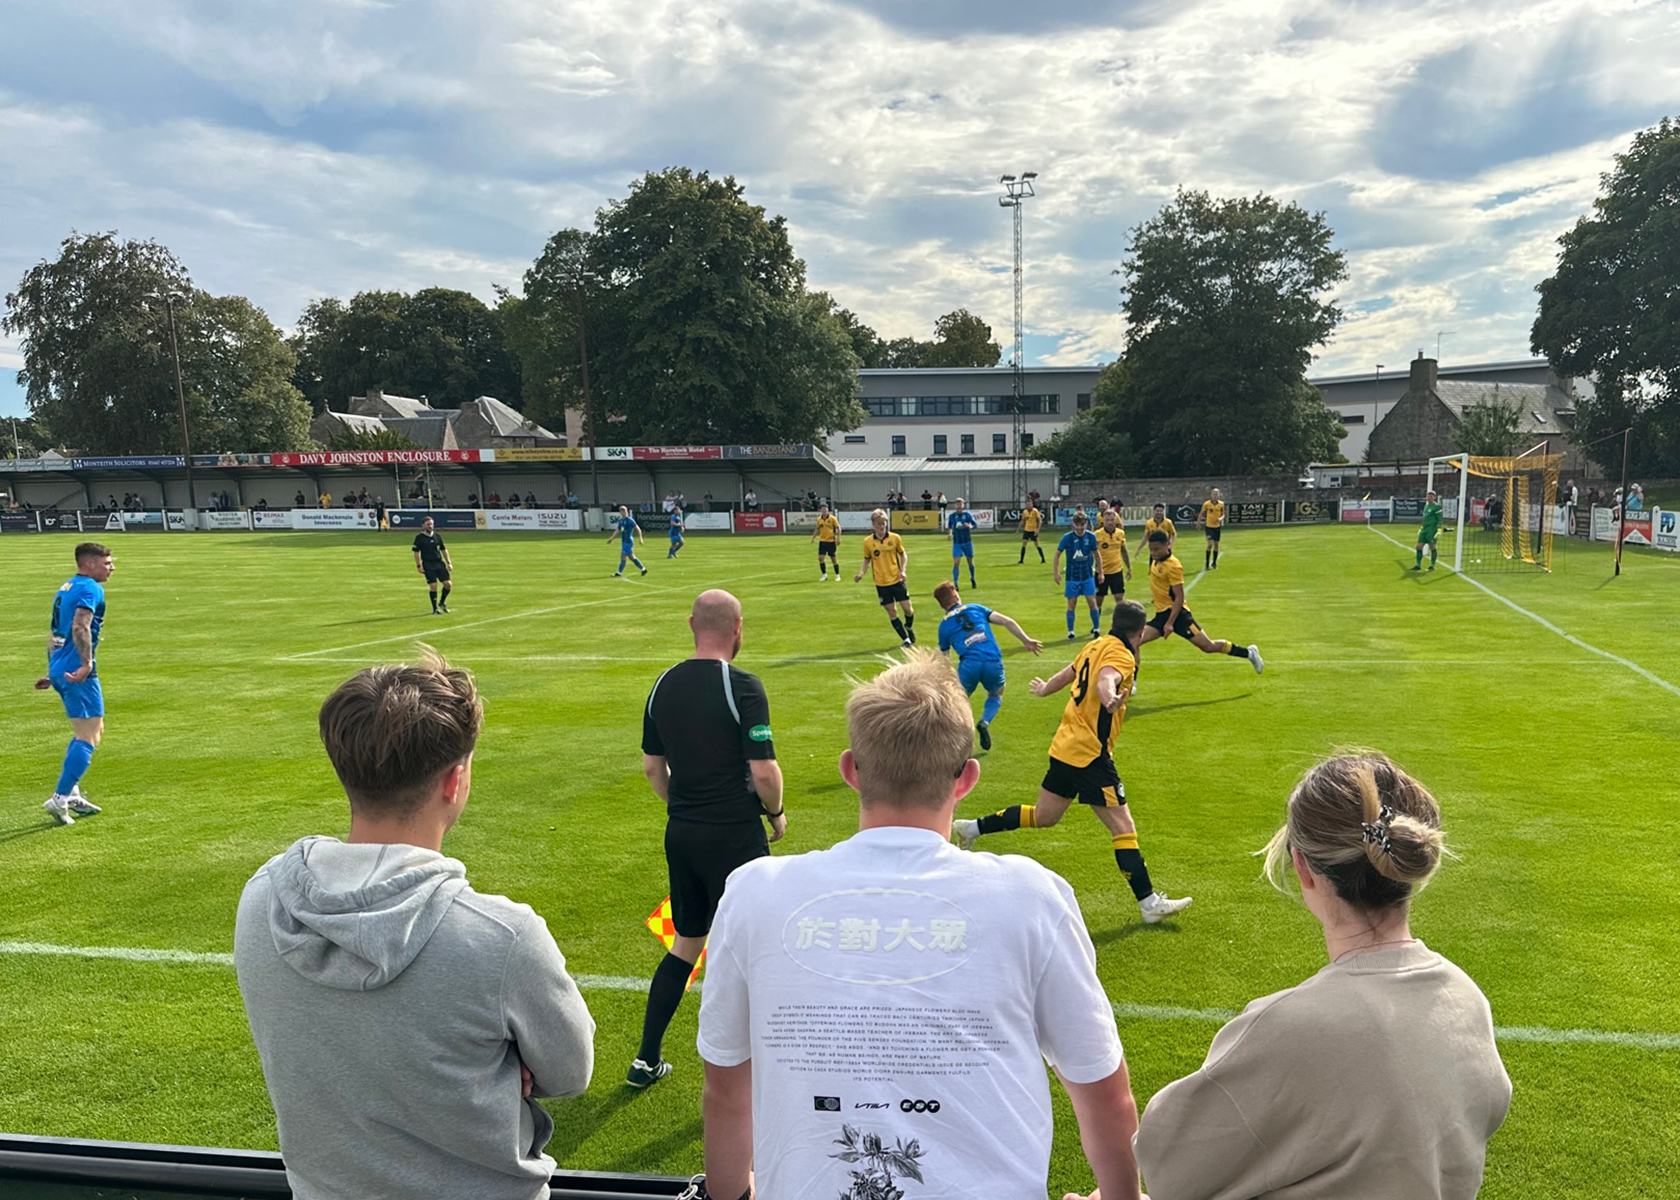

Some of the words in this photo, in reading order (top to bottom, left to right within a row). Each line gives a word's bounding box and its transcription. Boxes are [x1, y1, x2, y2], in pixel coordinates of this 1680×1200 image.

[300, 453, 326, 464] DAVY
[330, 453, 383, 463] JOHNSTON
[388, 451, 451, 462] ENCLOSURE
[607, 448, 626, 456] SIGN
[1004, 510, 1045, 520] ASHS
[1292, 502, 1320, 515] JGS
[955, 614, 976, 631] 3
[1071, 657, 1089, 706] 9
[795, 917, 967, 953] 於對大眾
[901, 1101, 939, 1111] EST
